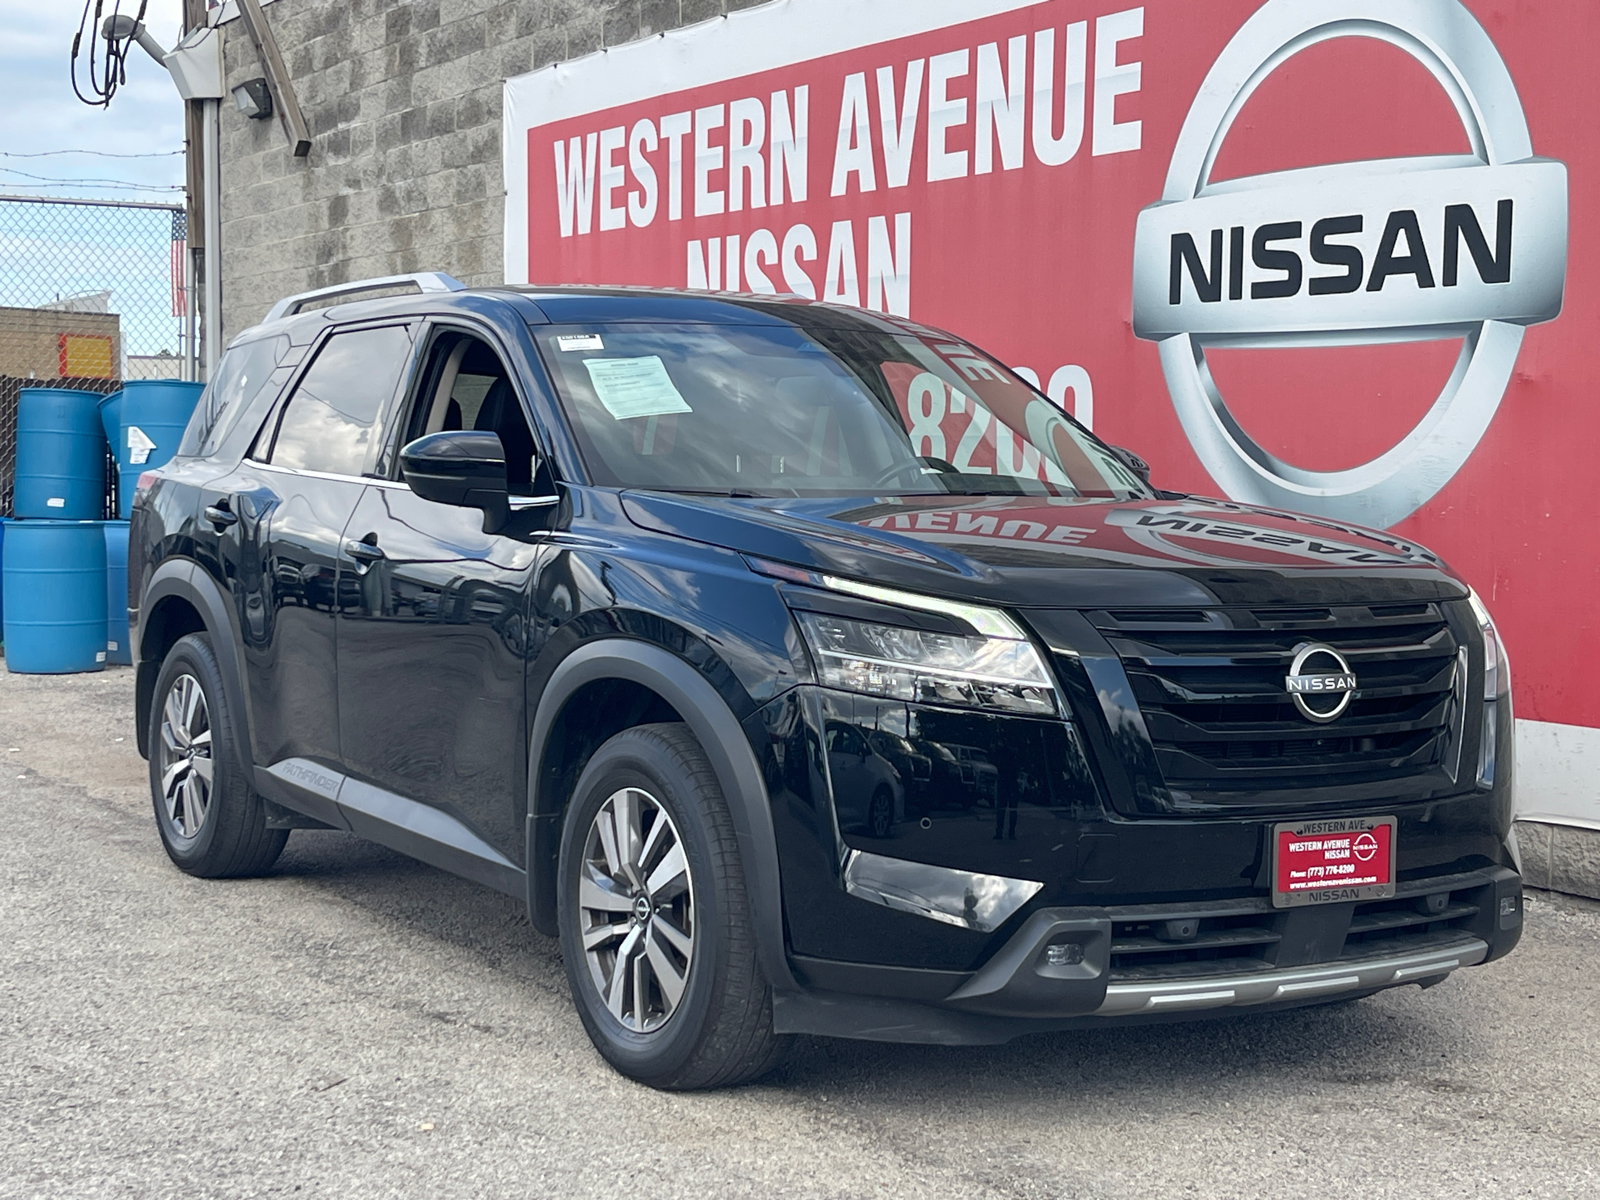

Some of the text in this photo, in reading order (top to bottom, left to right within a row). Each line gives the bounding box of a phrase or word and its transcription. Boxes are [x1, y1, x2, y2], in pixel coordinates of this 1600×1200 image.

[553, 6, 1145, 238] WESTERN AVENUE
[1169, 199, 1513, 305] NISSAN
[687, 211, 911, 320] NISSAN
[1289, 676, 1356, 690] NISSAN
[282, 761, 340, 793] PATHFINDER
[1303, 821, 1345, 833] WESTERN
[1289, 839, 1350, 852] WESTERN AVENUE
[1324, 849, 1350, 860] NISSAN
[1307, 866, 1324, 878] (773)
[1325, 864, 1355, 876] 776-8200
[1308, 889, 1360, 902] NISSAN
